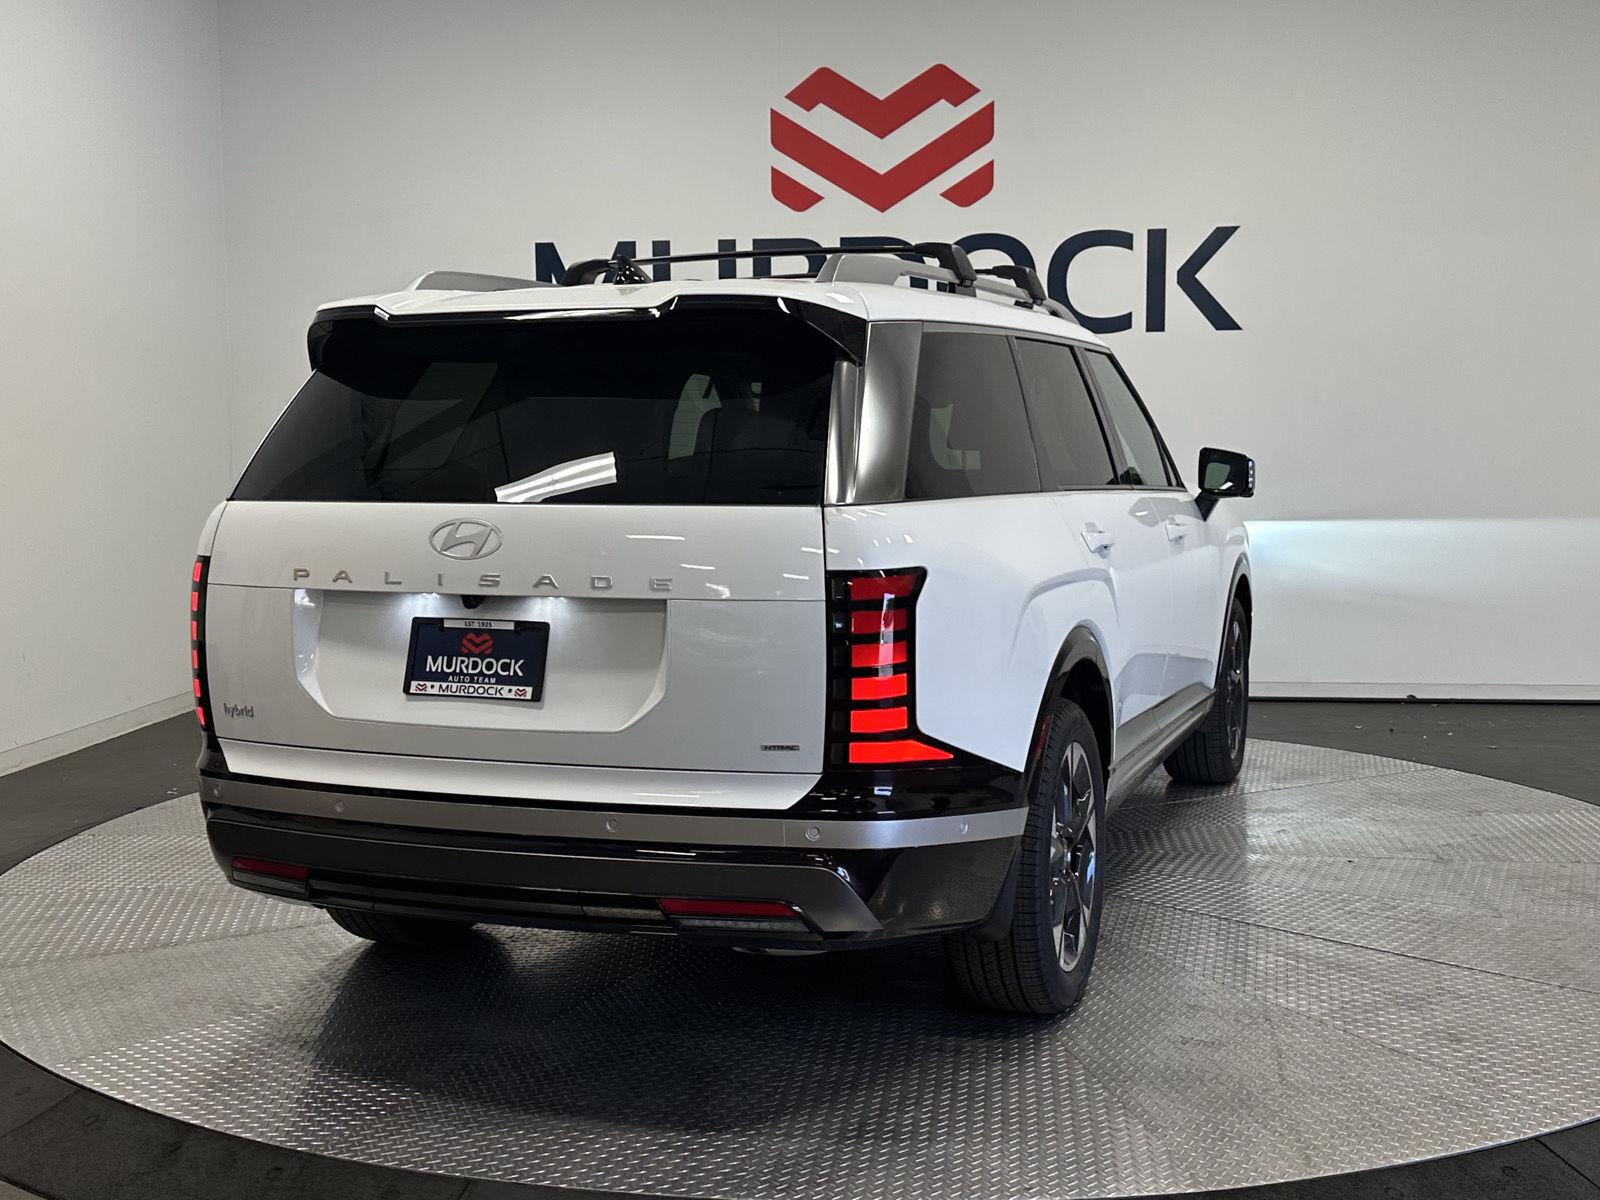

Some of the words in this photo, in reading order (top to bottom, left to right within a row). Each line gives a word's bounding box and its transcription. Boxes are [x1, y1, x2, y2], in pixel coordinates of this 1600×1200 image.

[293, 568, 673, 591] PALISADE
[425, 655, 525, 676] MURDOCK
[447, 675, 470, 683] AUTO
[473, 676, 496, 684] TEAM
[438, 684, 504, 696] MURDOCK
[223, 702, 254, 718] hybrid
